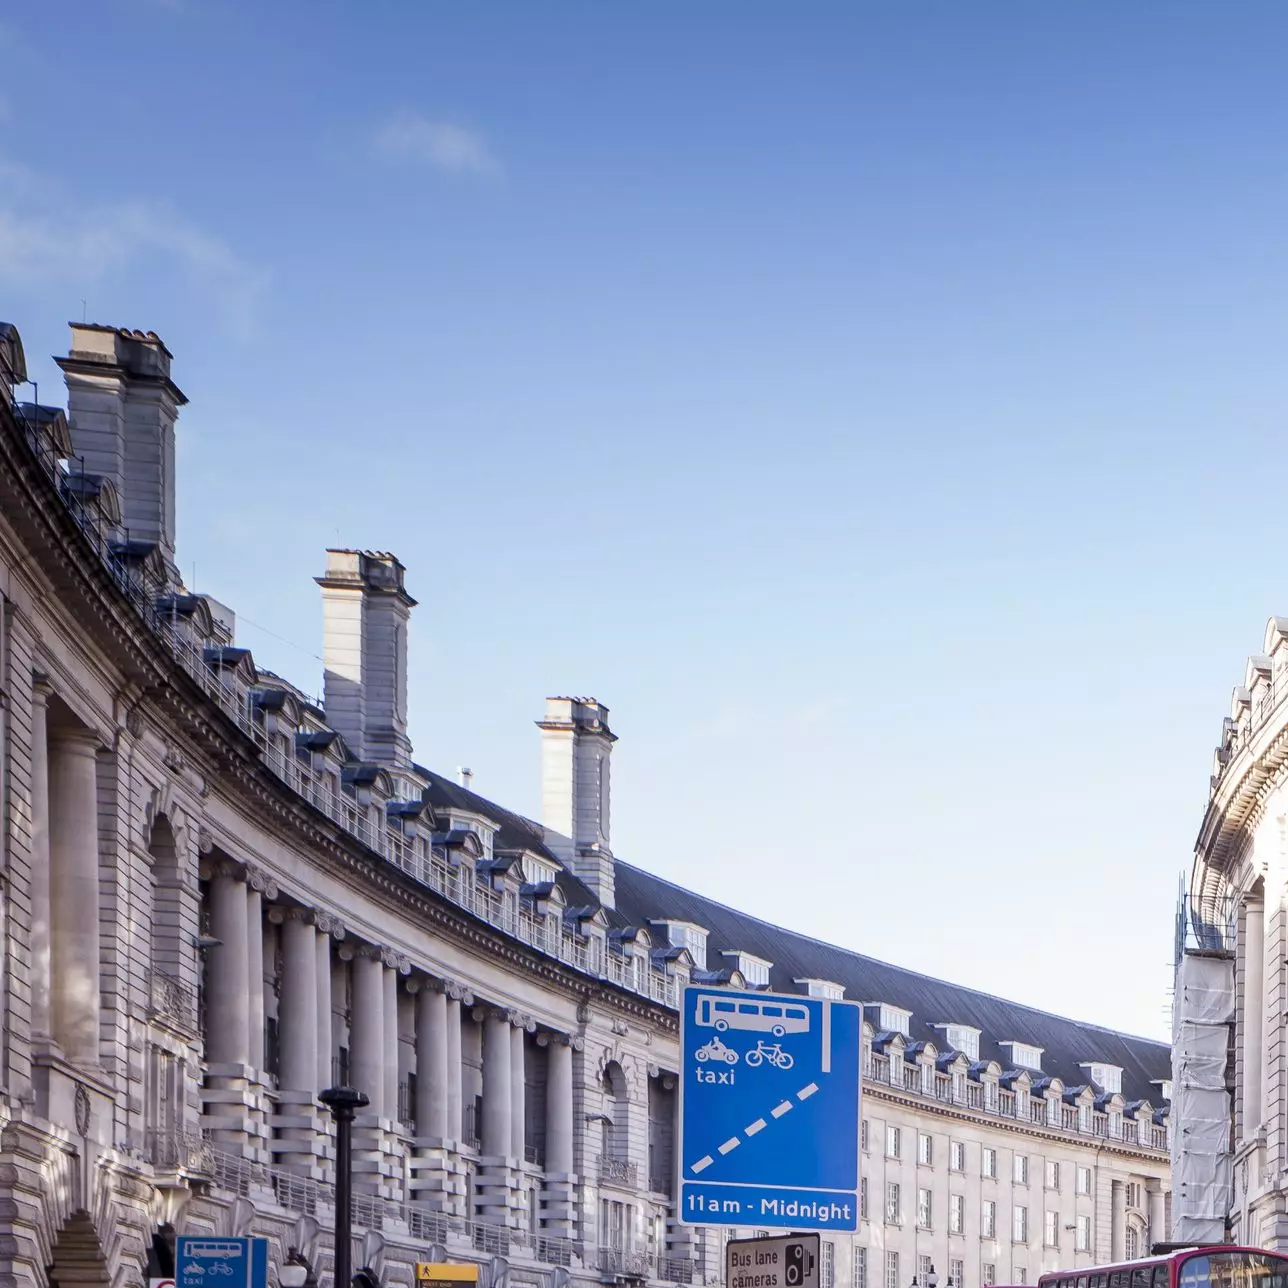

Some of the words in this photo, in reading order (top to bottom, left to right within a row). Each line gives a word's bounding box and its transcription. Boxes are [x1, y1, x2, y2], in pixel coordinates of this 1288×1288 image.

[696, 1066, 735, 1085] taxi
[761, 1198, 850, 1221] Midnight
[731, 1252, 751, 1267] Bus
[755, 1250, 778, 1266] lane
[183, 1277, 203, 1285] taxi
[732, 1272, 778, 1288] cameras
